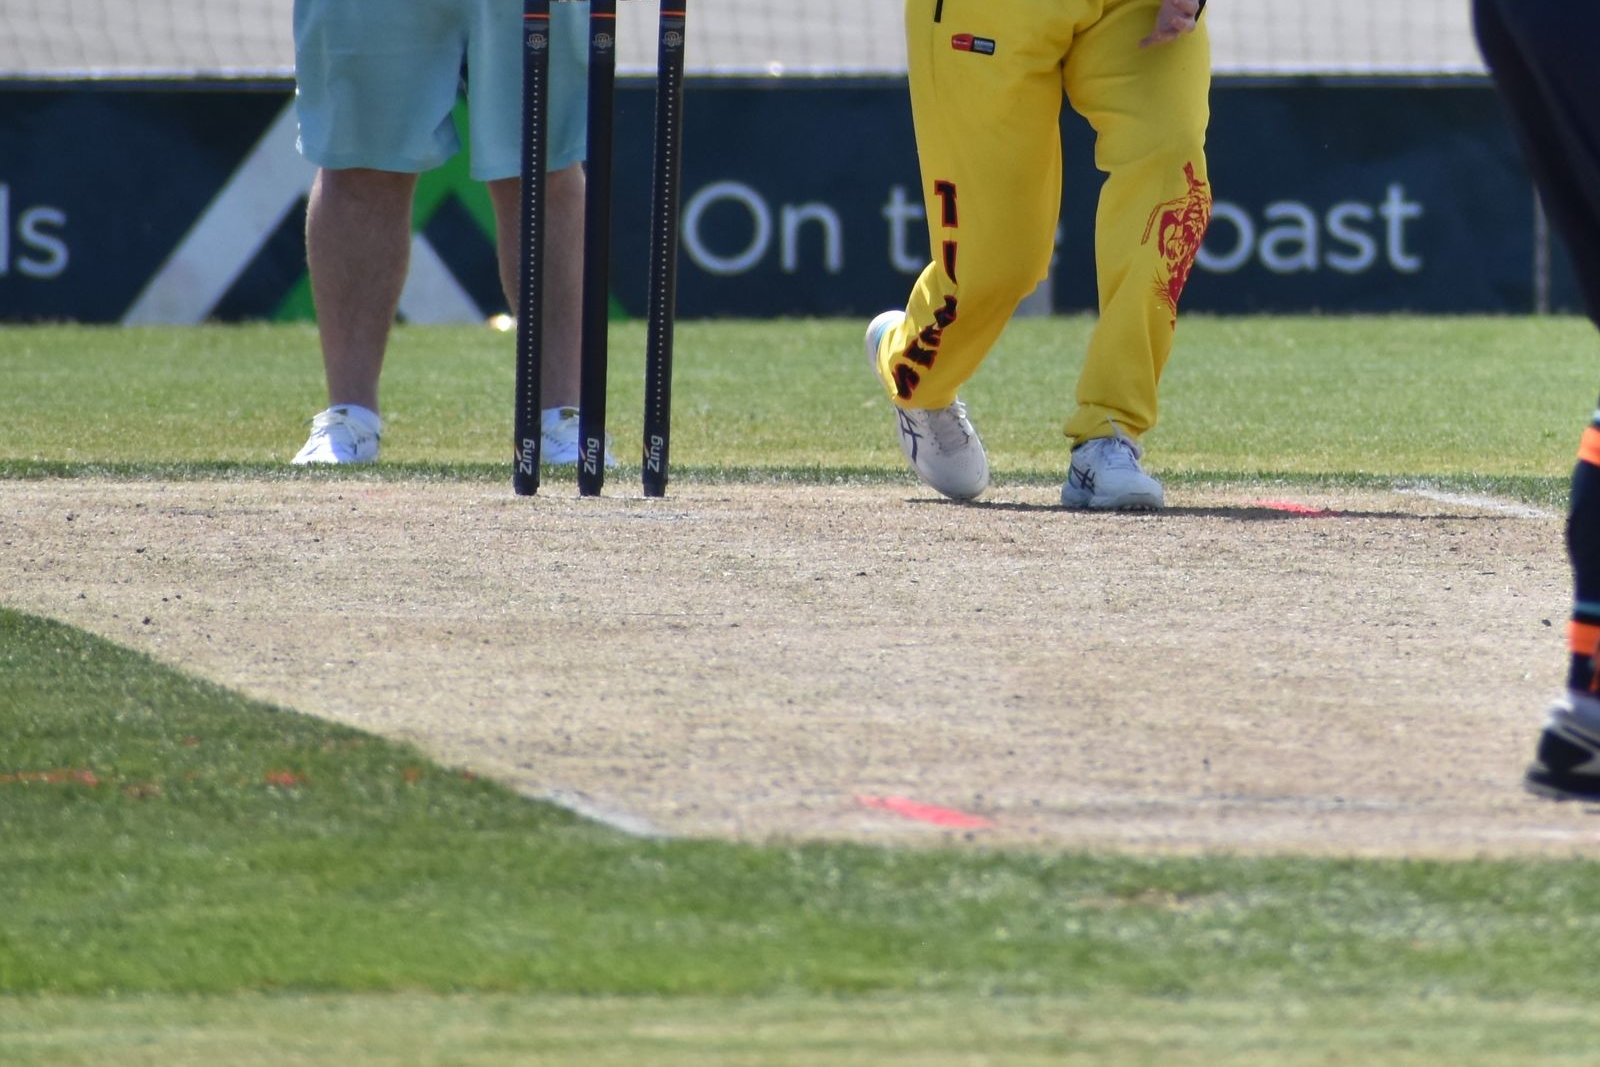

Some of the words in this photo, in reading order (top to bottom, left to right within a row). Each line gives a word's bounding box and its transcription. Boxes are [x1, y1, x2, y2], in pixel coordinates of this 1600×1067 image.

[682, 181, 843, 275] On
[1196, 183, 1423, 275] oast
[518, 438, 535, 475] Zing
[583, 437, 599, 475] Zing
[647, 435, 663, 472] Zing
